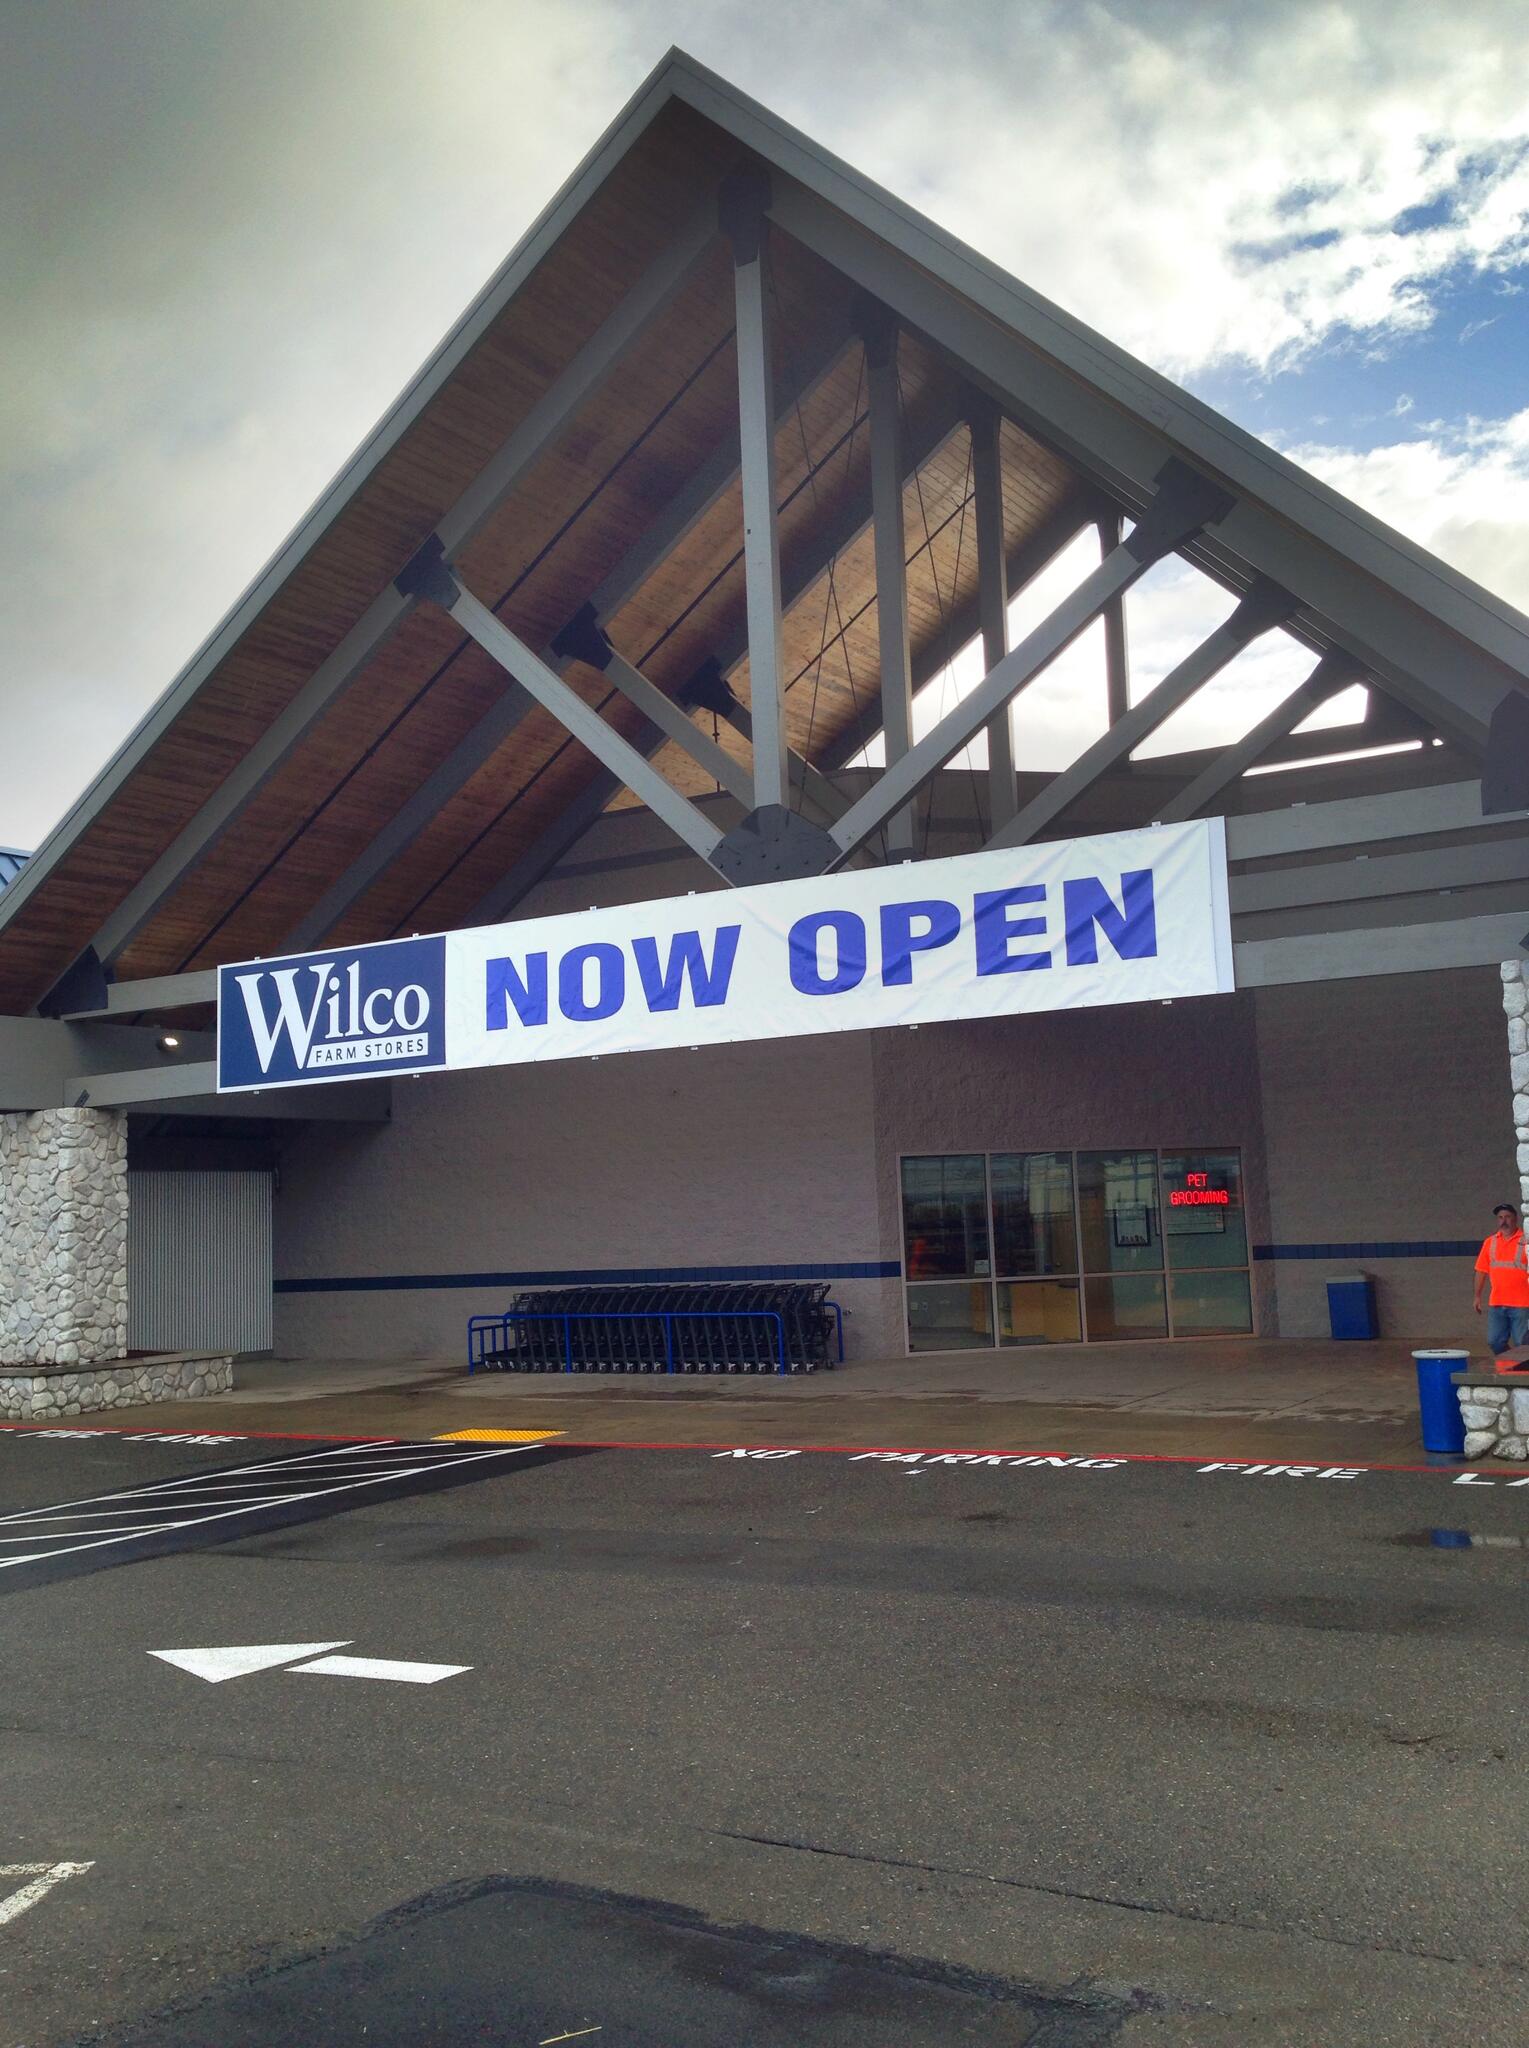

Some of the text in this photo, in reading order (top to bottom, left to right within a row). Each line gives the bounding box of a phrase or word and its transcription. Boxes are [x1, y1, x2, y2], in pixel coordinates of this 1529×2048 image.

[486, 870, 1157, 1032] NOW OPEN
[234, 960, 431, 1074] Wilco
[315, 1038, 425, 1063] FARM STORES
[1187, 1173, 1208, 1187] PET
[1170, 1190, 1229, 1206] GROOMING
[121, 1432, 249, 1445] LANE
[710, 1448, 803, 1460] NO
[847, 1451, 1128, 1469] PARKING
[1195, 1462, 1369, 1480] FIRE
